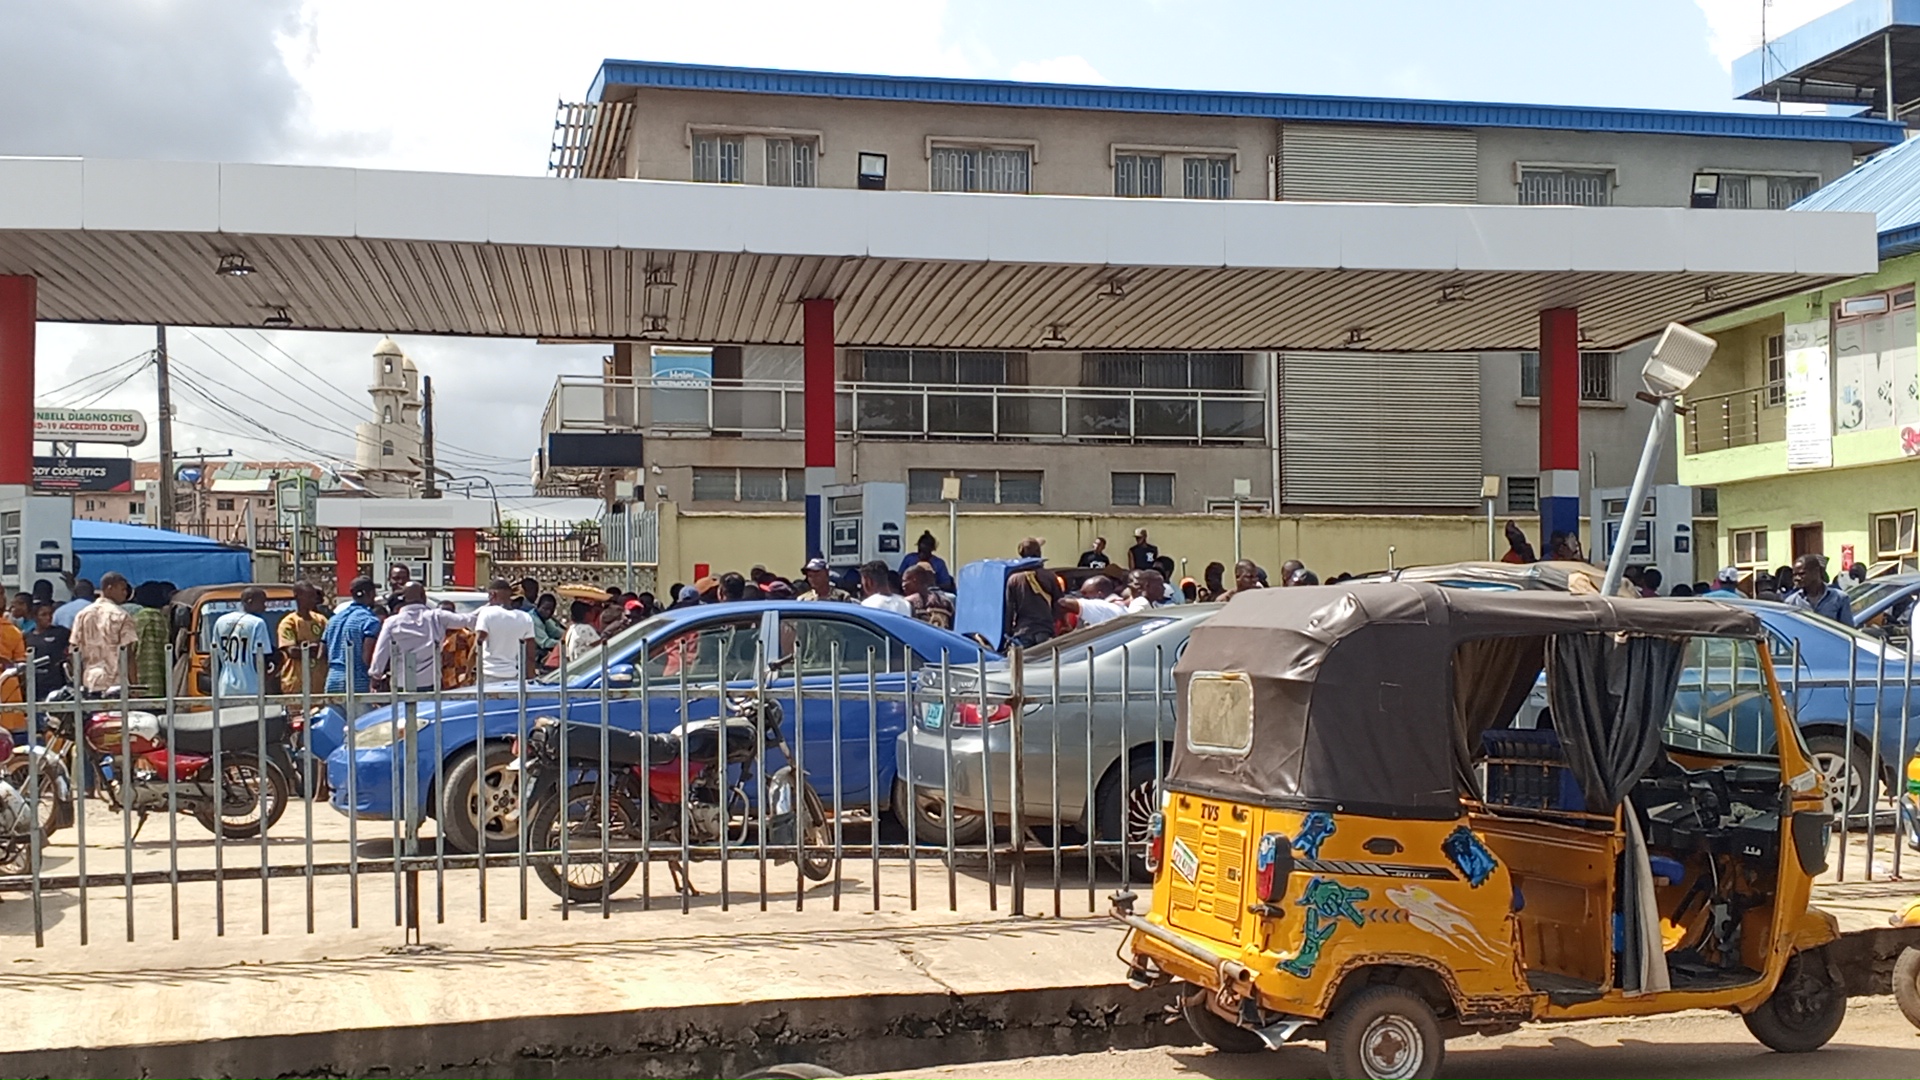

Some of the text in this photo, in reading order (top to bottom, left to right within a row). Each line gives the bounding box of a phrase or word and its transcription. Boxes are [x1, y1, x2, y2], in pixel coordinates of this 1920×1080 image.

[68, 412, 133, 422] DIAGNOSTICS
[59, 422, 108, 431] ACCREDITED
[109, 423, 140, 432] CENTRE
[51, 466, 107, 477] COSMETICS
[1201, 802, 1220, 822] TVS
